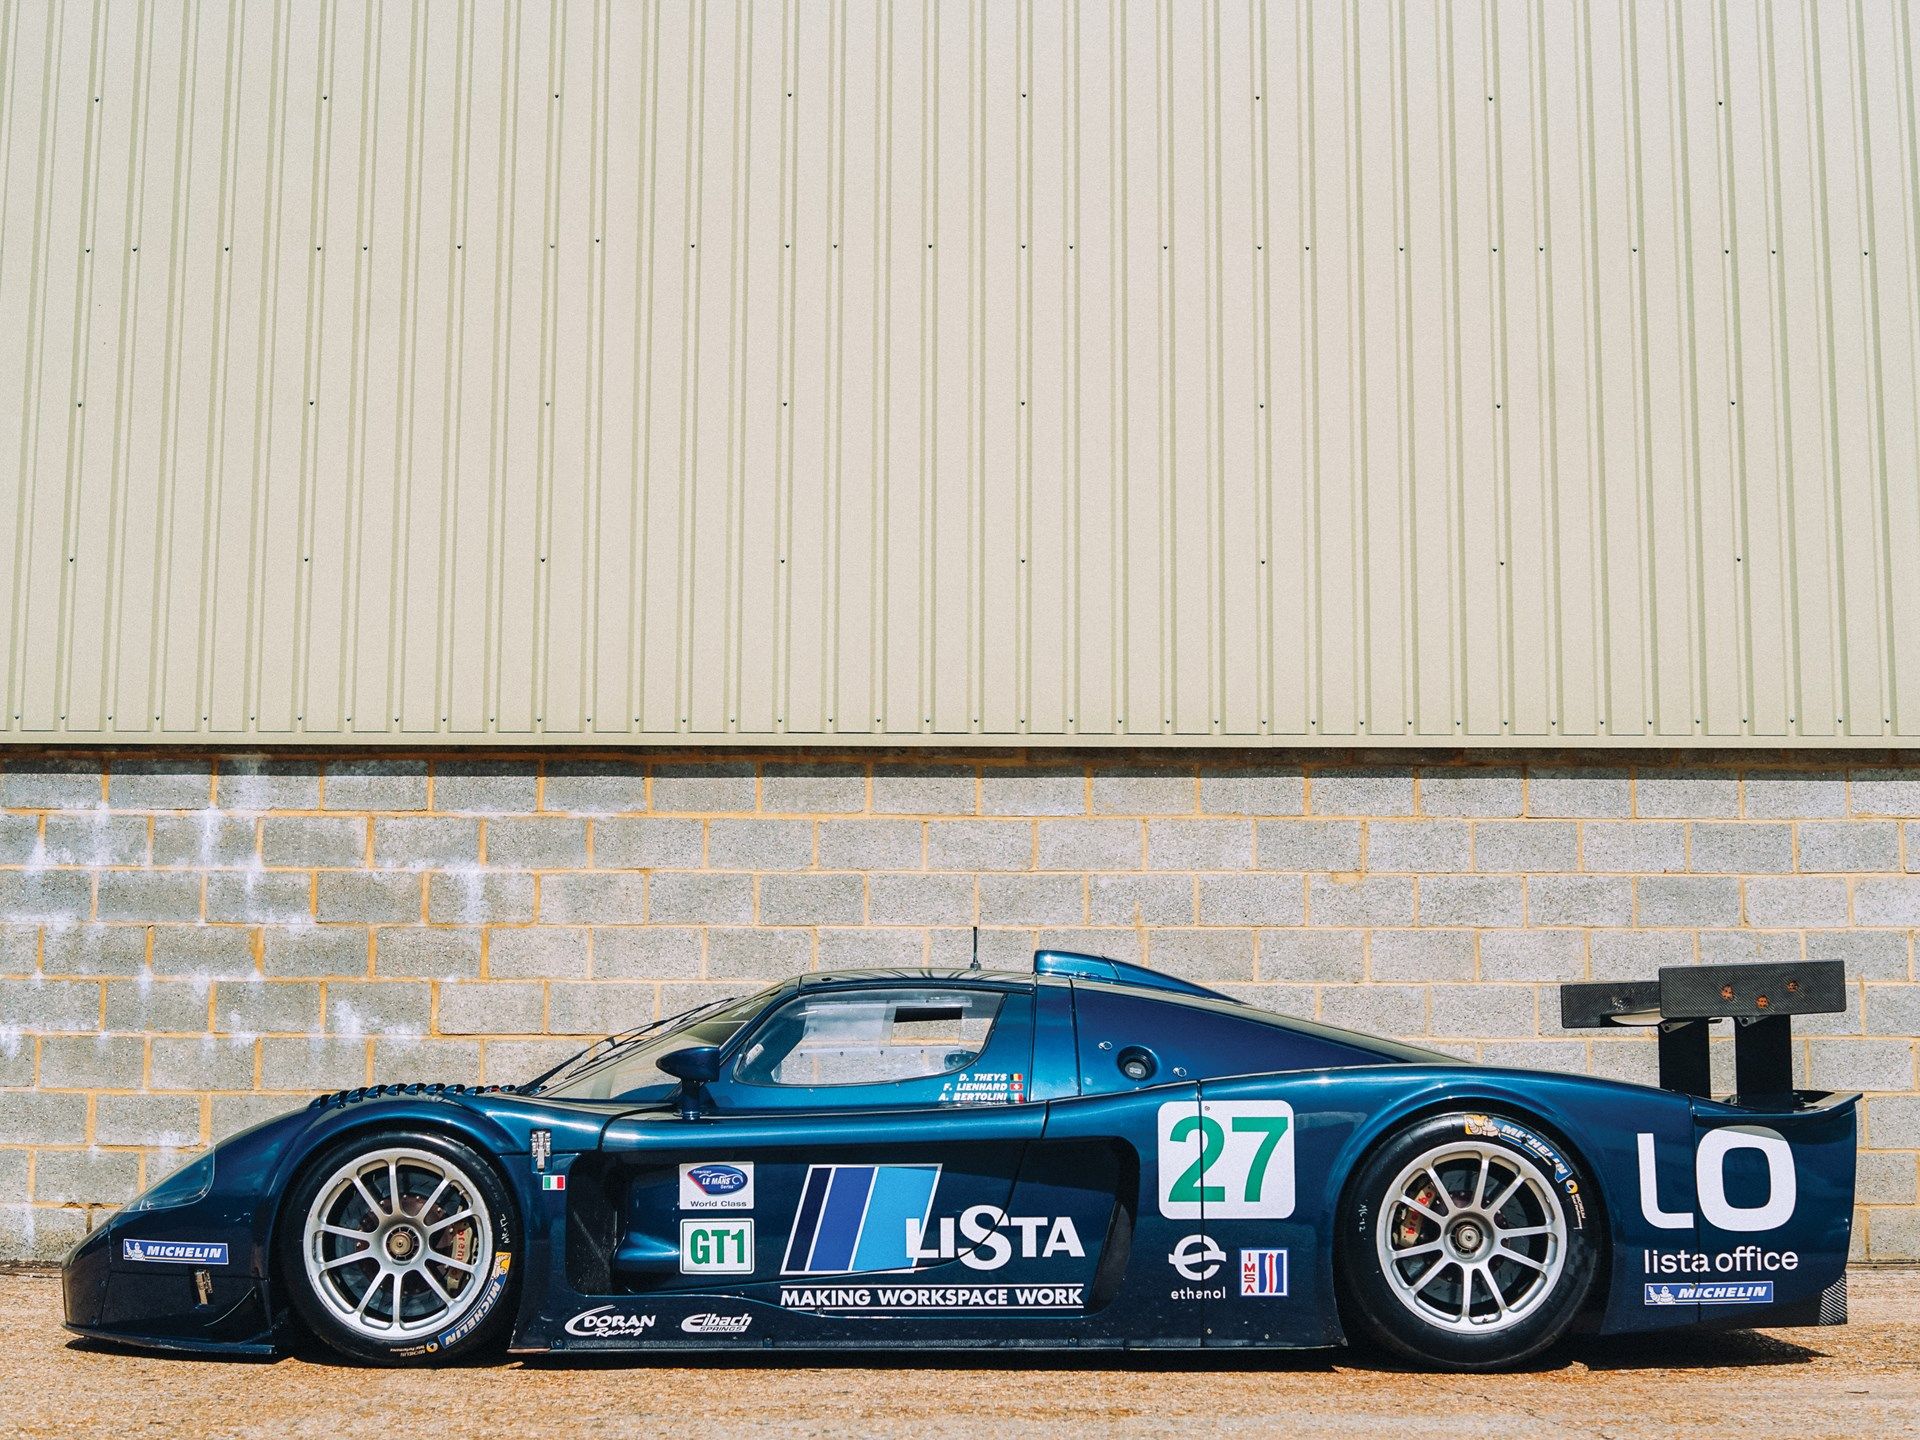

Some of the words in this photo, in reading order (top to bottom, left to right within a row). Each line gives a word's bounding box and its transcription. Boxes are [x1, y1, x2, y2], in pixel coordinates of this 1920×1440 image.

[959, 1073, 969, 1081] D.
[973, 1073, 1007, 1081] THEYS
[943, 1083, 953, 1091] F.
[956, 1083, 1008, 1091] LIENHARD
[938, 1092, 949, 1101] A.
[953, 1092, 1008, 1101] BERTOLINI
[1168, 1116, 1288, 1202] 27
[702, 1177, 711, 1185] LE
[711, 1176, 732, 1185] MANS
[1637, 1125, 1797, 1231] LO
[905, 1204, 1086, 1271] LISTA
[146, 1245, 222, 1259] MICHELIN
[690, 1228, 745, 1265] GT1
[1644, 1249, 1711, 1274] lista
[1715, 1245, 1799, 1273] office
[1243, 1252, 1256, 1294] IMSA
[780, 1289, 871, 1306] MAKING
[877, 1289, 1008, 1306] WORKSPACE
[1015, 1288, 1084, 1305] WORK
[1170, 1286, 1226, 1300] ethanol
[1677, 1286, 1767, 1299] MICHELIN
[445, 1281, 501, 1346] MICHELIN
[583, 1314, 656, 1328] DORAN
[681, 1313, 753, 1332] Eibach
[594, 1326, 644, 1338] Racing
